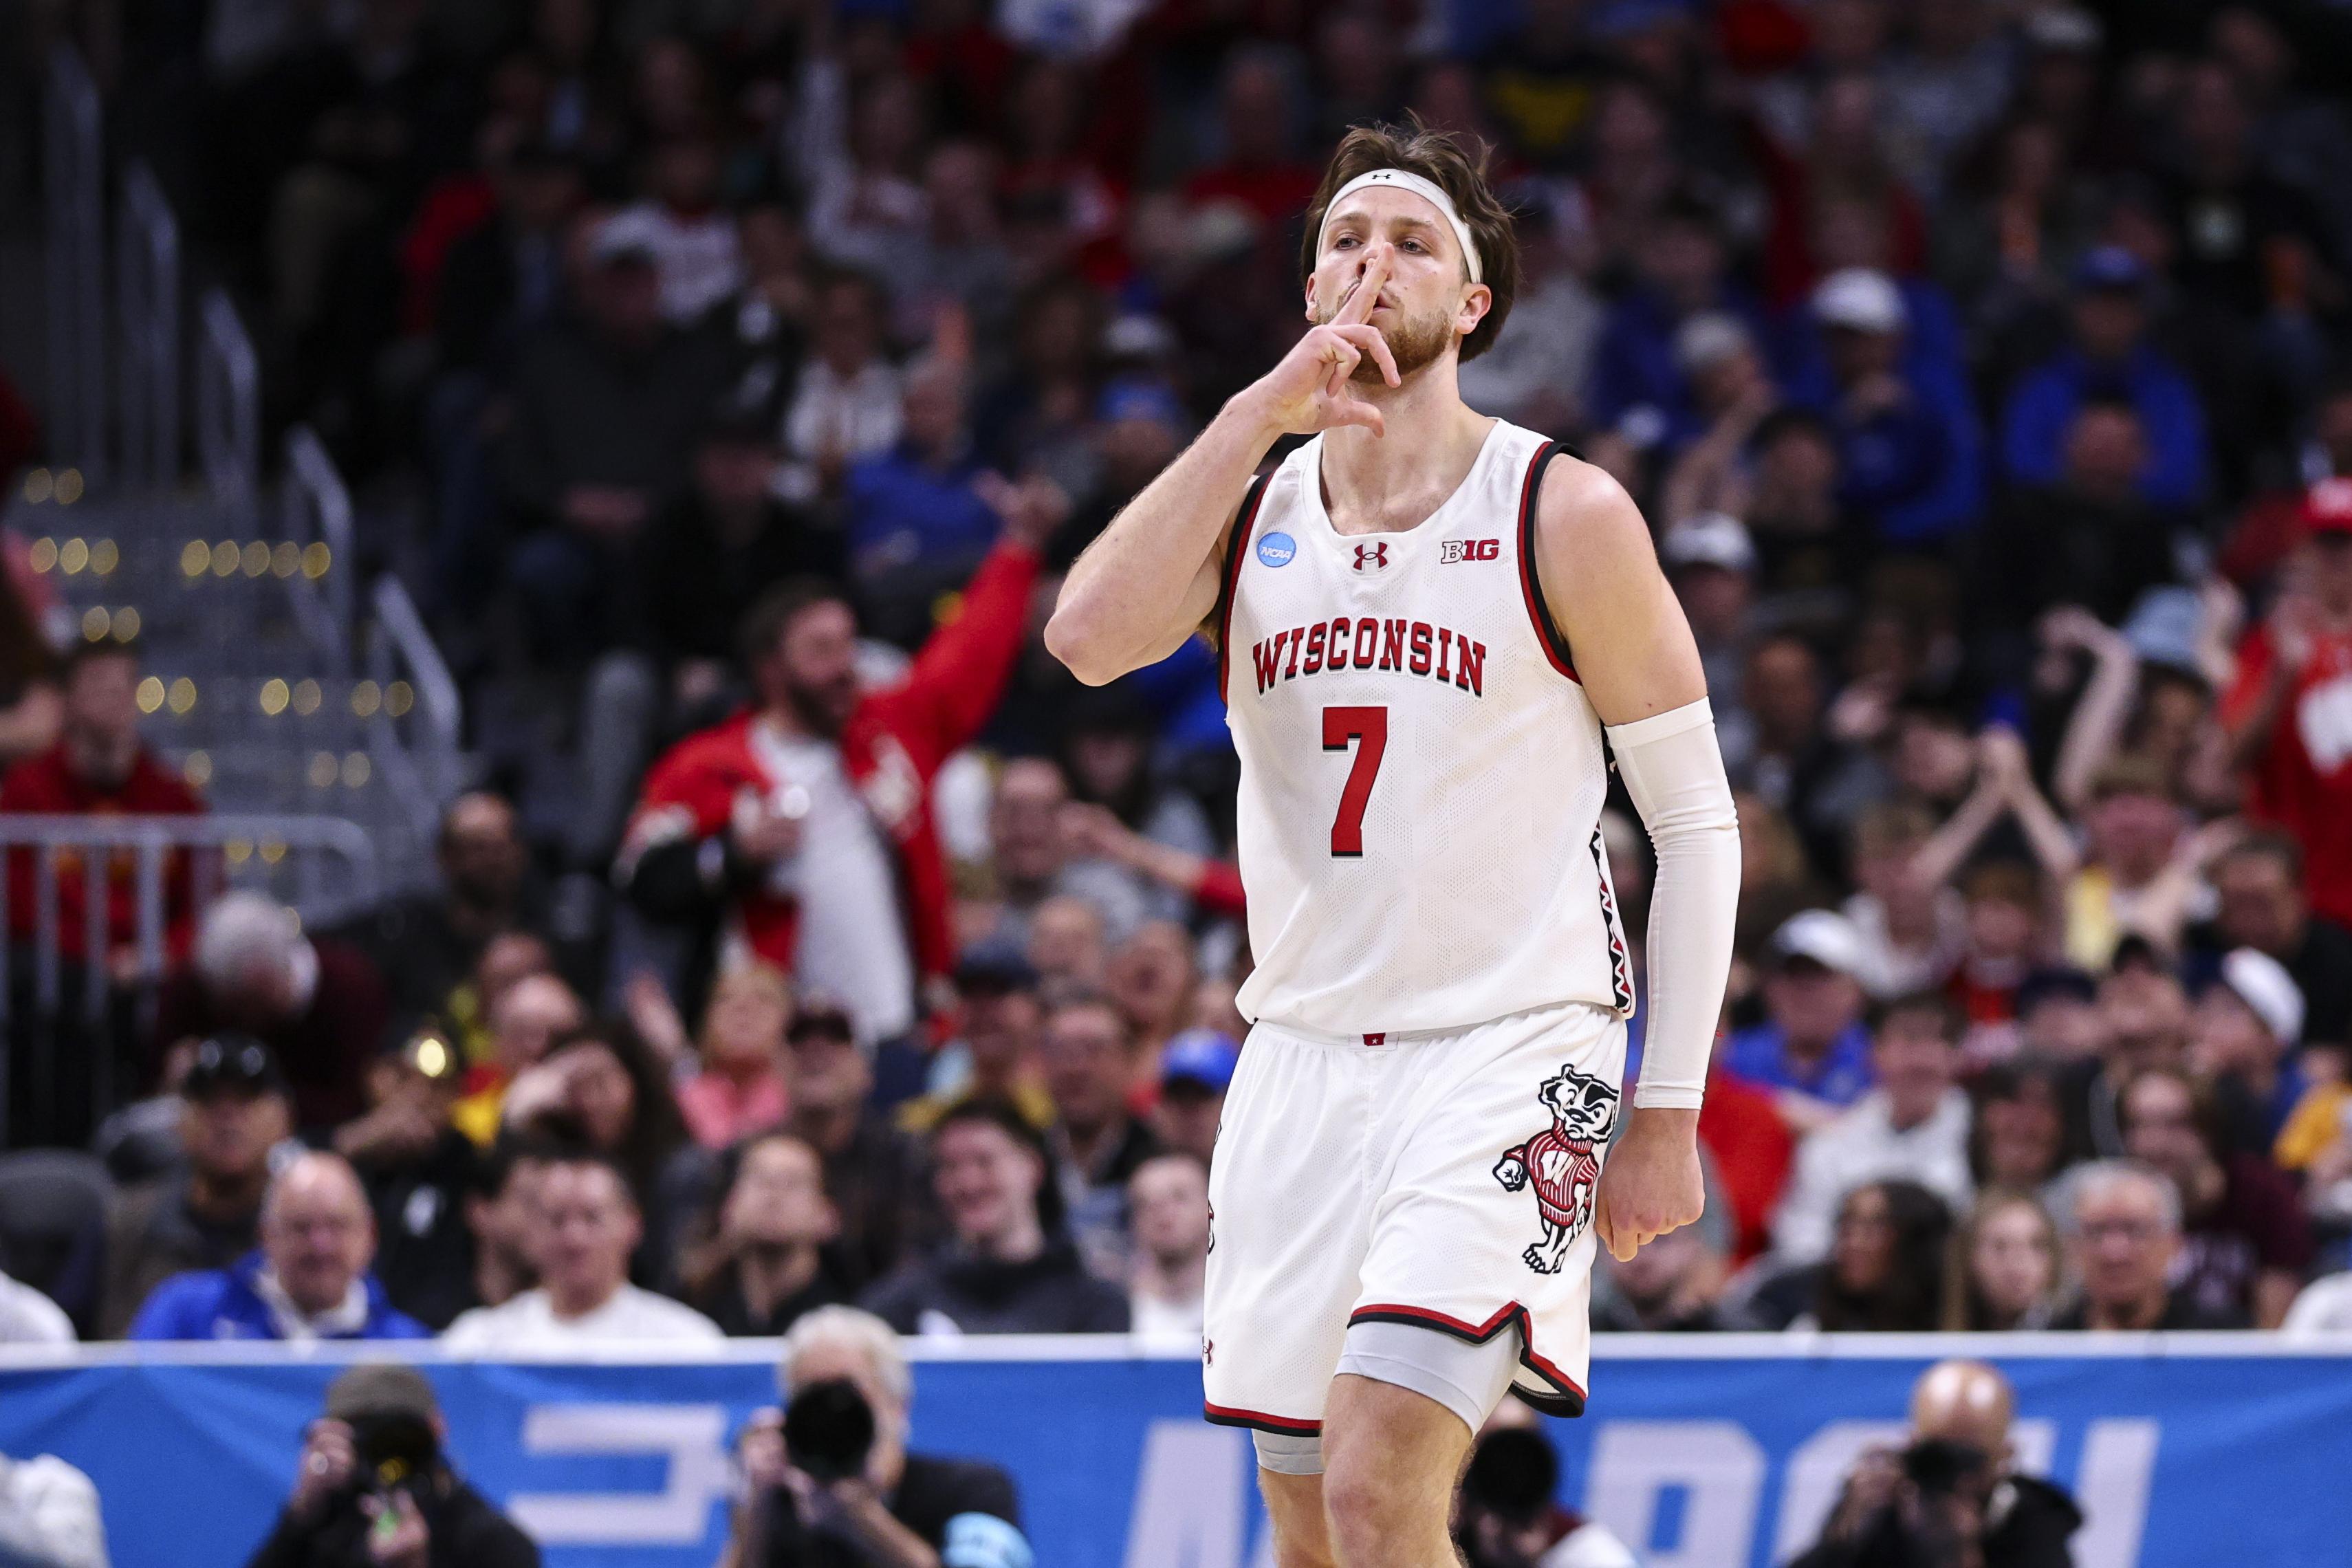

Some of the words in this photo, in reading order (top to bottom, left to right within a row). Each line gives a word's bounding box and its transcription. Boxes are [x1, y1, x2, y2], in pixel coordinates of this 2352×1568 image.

[1261, 547, 1292, 559] NCAA
[1441, 539, 1499, 564] BIG
[1252, 617, 1486, 698] WISCONSIN
[1322, 706, 1388, 858] 7
